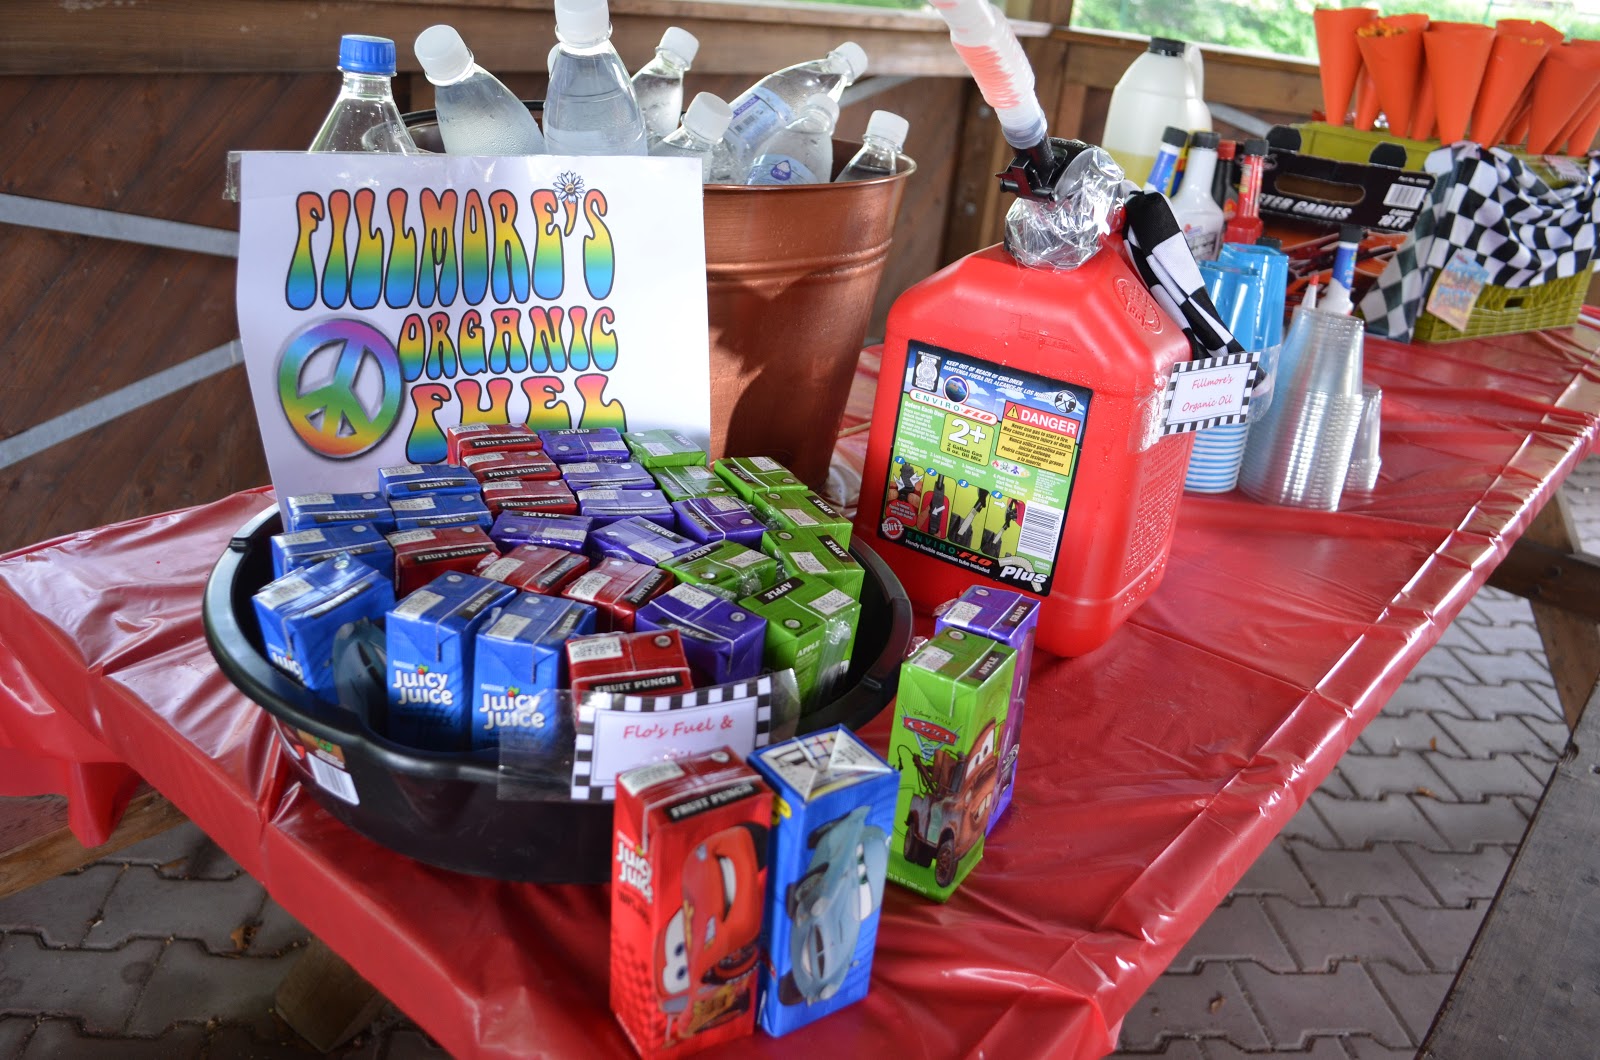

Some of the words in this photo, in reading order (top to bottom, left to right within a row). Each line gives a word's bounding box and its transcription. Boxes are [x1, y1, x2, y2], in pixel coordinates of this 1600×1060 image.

[1292, 200, 1352, 220] CABLES
[285, 187, 615, 310] FILLMORE'S
[398, 306, 618, 382] ORGANIC
[1192, 374, 1233, 390] Fillmore's
[916, 393, 960, 411] ENVIRO
[963, 409, 992, 421] FLO
[1182, 398, 1216, 412] Organic
[1218, 394, 1232, 406] Oil
[406, 374, 628, 464] FUEL
[1021, 410, 1076, 434] DANGER
[948, 418, 986, 446] 2+
[952, 444, 970, 453] Gallon
[488, 470, 515, 478] FRUIT
[517, 466, 547, 475] PUNCH
[419, 480, 455, 489] BERRY
[814, 499, 835, 514] APPLE
[430, 516, 466, 525] BERRY
[882, 522, 904, 532] Blitz
[645, 524, 675, 538] GRAPE
[417, 552, 448, 562] FRUIT
[450, 547, 486, 558] PUNCH
[688, 546, 711, 561] APPLE
[825, 540, 848, 557] APPLE
[906, 532, 956, 554] ENVIRO
[959, 552, 992, 566] FLO
[1000, 566, 1047, 582] Plus
[764, 582, 793, 600] APPLE
[469, 592, 491, 612] BERRY
[1009, 605, 1028, 622] GRAPE
[796, 640, 820, 657] APPLE
[979, 656, 999, 675] APPLE
[392, 668, 448, 690] Juicy
[595, 682, 632, 693] FRUIT
[634, 675, 676, 689] PUNCH
[398, 688, 454, 705] Juice
[479, 693, 542, 714] Juicy
[484, 710, 546, 730] Juice
[623, 724, 668, 739] Flo's
[673, 720, 715, 736] Fuel
[720, 715, 734, 729] &
[670, 798, 710, 818] FRUIT
[710, 784, 754, 804] PUNCH
